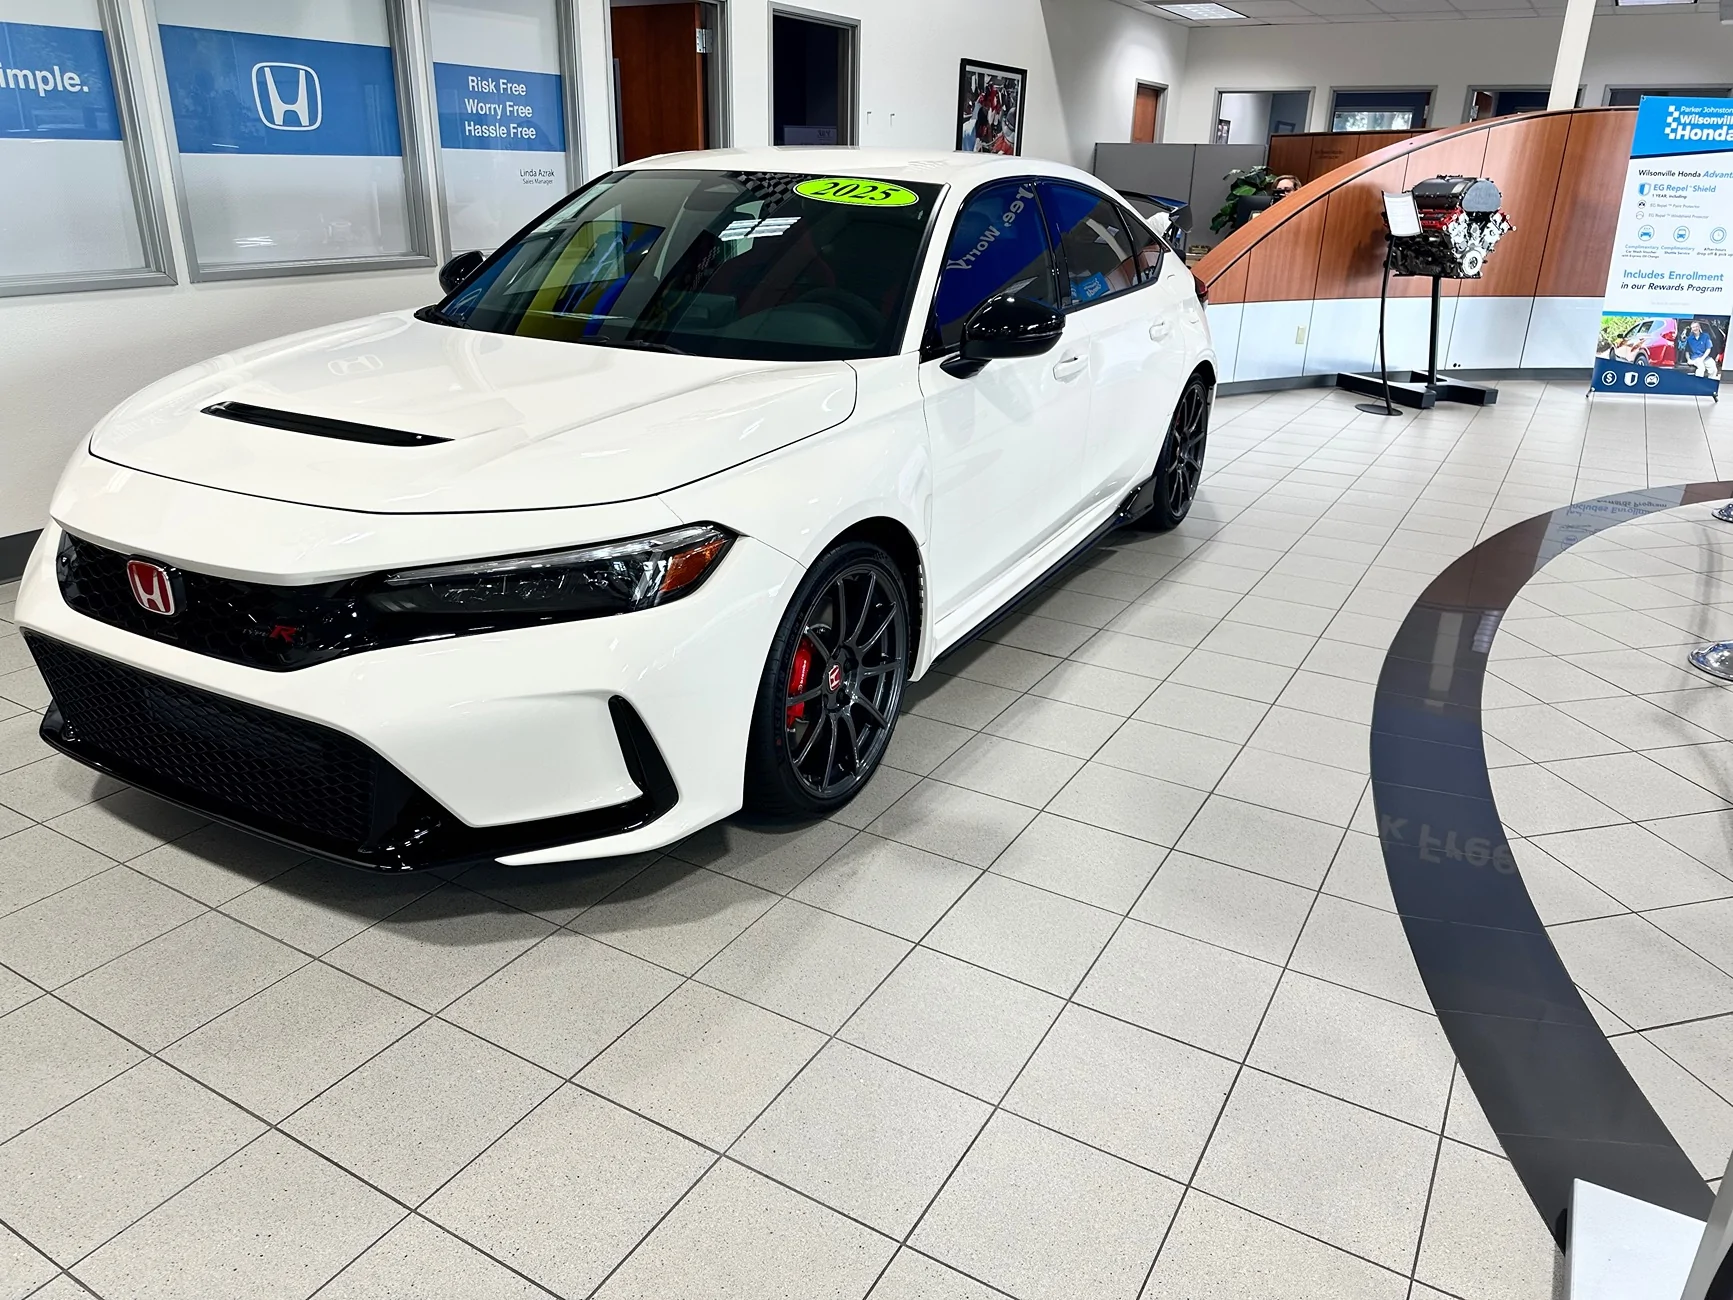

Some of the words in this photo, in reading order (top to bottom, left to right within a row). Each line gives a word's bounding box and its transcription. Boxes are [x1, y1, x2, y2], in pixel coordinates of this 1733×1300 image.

[468, 76, 497, 93] Risk
[499, 79, 527, 95] Free
[464, 98, 503, 119] Worry
[506, 102, 533, 118] Free
[464, 121, 507, 138] Hassle
[509, 123, 536, 139] Free
[1676, 125, 1733, 141] Honda
[520, 168, 537, 177] Linda
[538, 168, 555, 177] Azrak
[1638, 169, 1676, 177] Wilsonville
[1702, 171, 1733, 179] Advant
[534, 178, 553, 186] Manager
[1653, 183, 1665, 191] EG
[1692, 185, 1717, 193] Shield
[811, 181, 899, 201] 2025
[1623, 269, 1665, 280] Includes
[1668, 271, 1725, 282] Enrollment
[1620, 282, 1629, 290] in
[1648, 282, 1685, 291] Rewards
[1686, 284, 1723, 294] Program
